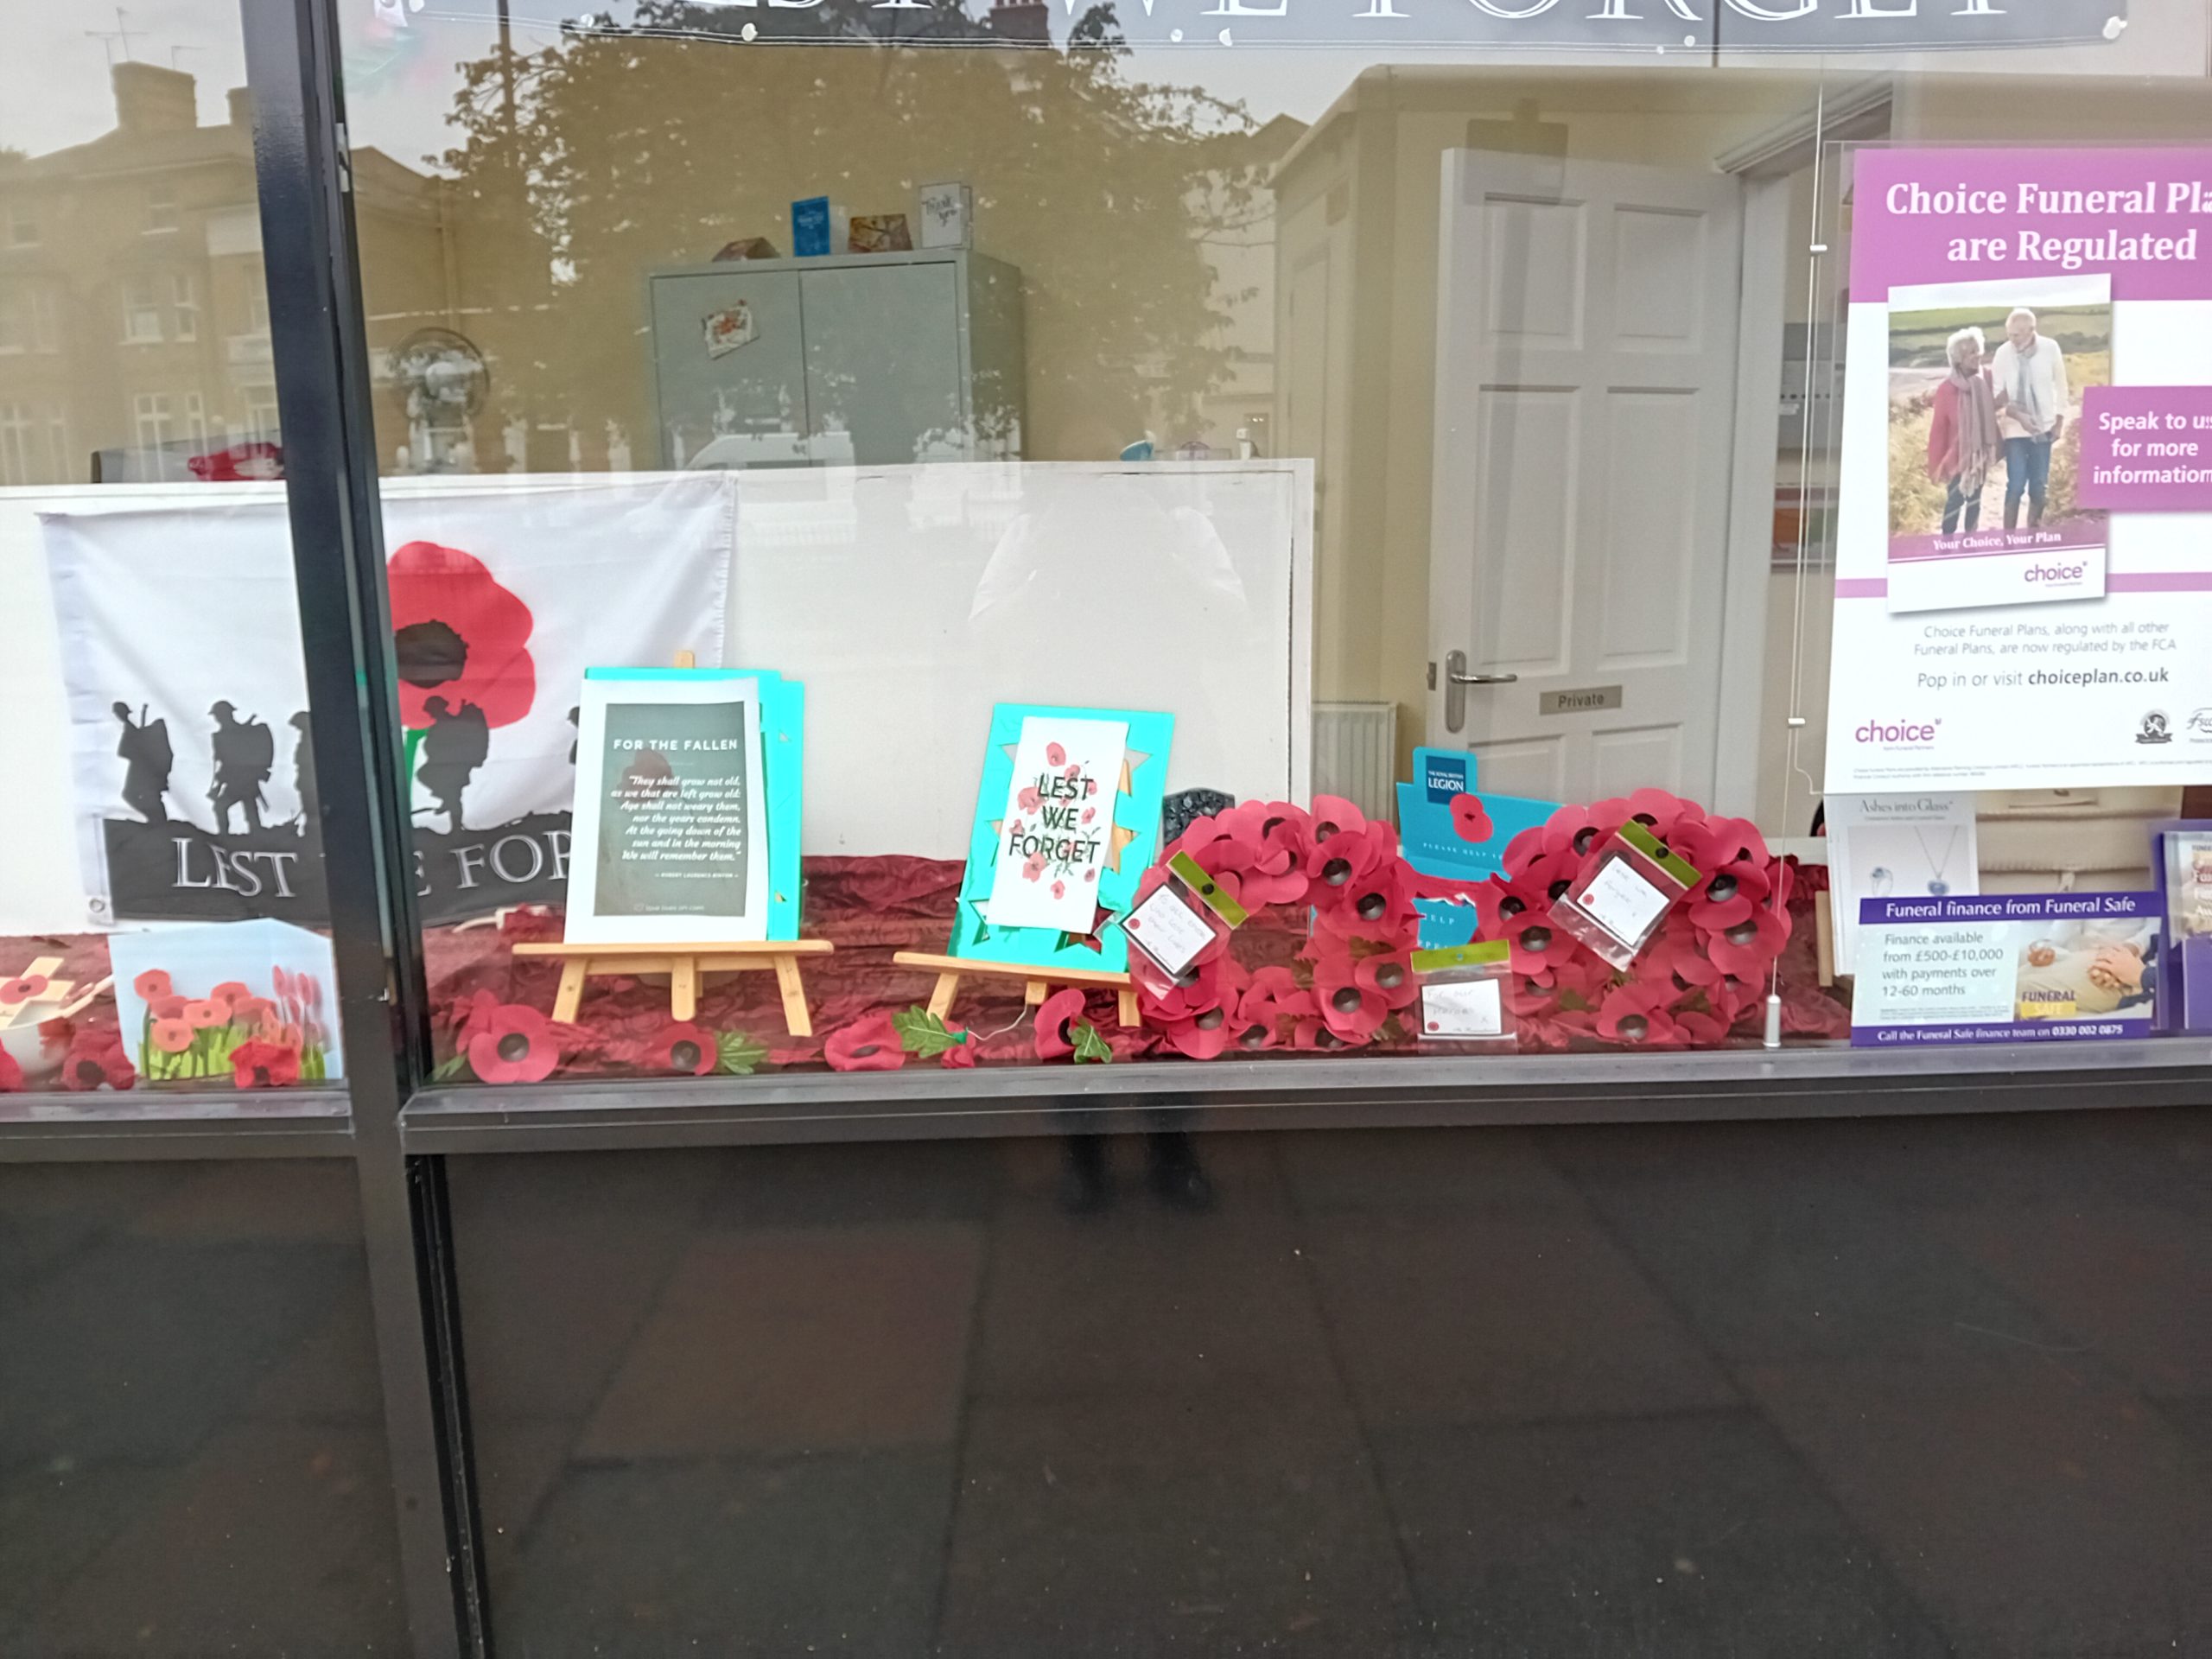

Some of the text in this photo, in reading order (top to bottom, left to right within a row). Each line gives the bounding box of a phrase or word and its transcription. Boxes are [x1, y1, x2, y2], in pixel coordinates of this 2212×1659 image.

[1886, 182, 2007, 214] Choice
[2016, 181, 2156, 214] Funeral
[1947, 228, 2197, 270] are Regulated
[2099, 410, 2159, 435] Speak
[2164, 413, 2187, 429] to
[2111, 438, 2198, 456] for more
[1933, 531, 2062, 550] Your Choice, Your Plan
[2024, 563, 2082, 582] choice
[1923, 620, 2170, 638] Choice Funeral Plans, along with all other
[1914, 638, 2177, 656] Funeral Plans, are now regulated by the FCA
[1917, 667, 2169, 690] Pop in or visit choiceplan.co.uk
[1558, 693, 1604, 708] Private
[1855, 719, 1935, 743] choice
[613, 739, 738, 751] FOR THE FALLEN
[656, 775, 680, 786] shall
[681, 779, 705, 788] grow
[707, 777, 723, 786] not
[1038, 773, 1094, 800] LEST
[1427, 777, 1464, 791] LEGION
[640, 788, 661, 798] that
[680, 788, 696, 799] left
[698, 791, 722, 800] grow
[620, 800, 639, 812] Age
[640, 800, 664, 810] shall
[665, 802, 682, 810] not
[683, 803, 713, 813] weary
[1894, 803, 1916, 811] into
[632, 814, 650, 823] nor
[652, 812, 666, 823] the
[669, 816, 695, 826] years
[1042, 805, 1078, 830] WE
[625, 825, 741, 837] At the going down of the
[632, 837, 741, 850] sun and in the morning
[1008, 835, 1100, 864] FORGET
[622, 849, 638, 860] We
[639, 850, 658, 860] will
[660, 850, 707, 861] remember
[171, 837, 298, 897] LEST
[1885, 896, 2136, 918] Funeral finance from Funeral Safe
[1885, 931, 1984, 945] Finance available
[1884, 949, 2004, 963] from £500-£10,000
[1882, 967, 1997, 982] with payments over
[1882, 983, 1966, 996] 12-60 months
[2022, 990, 2075, 1001] FUNERAL
[1878, 1031, 1897, 1041] Call
[1899, 1030, 1916, 1040] the
[1916, 1028, 1952, 1040] Funeral
[1954, 1028, 1974, 1039] Safe
[1975, 1027, 2011, 1039] finance
[2012, 1028, 2036, 1037] team
